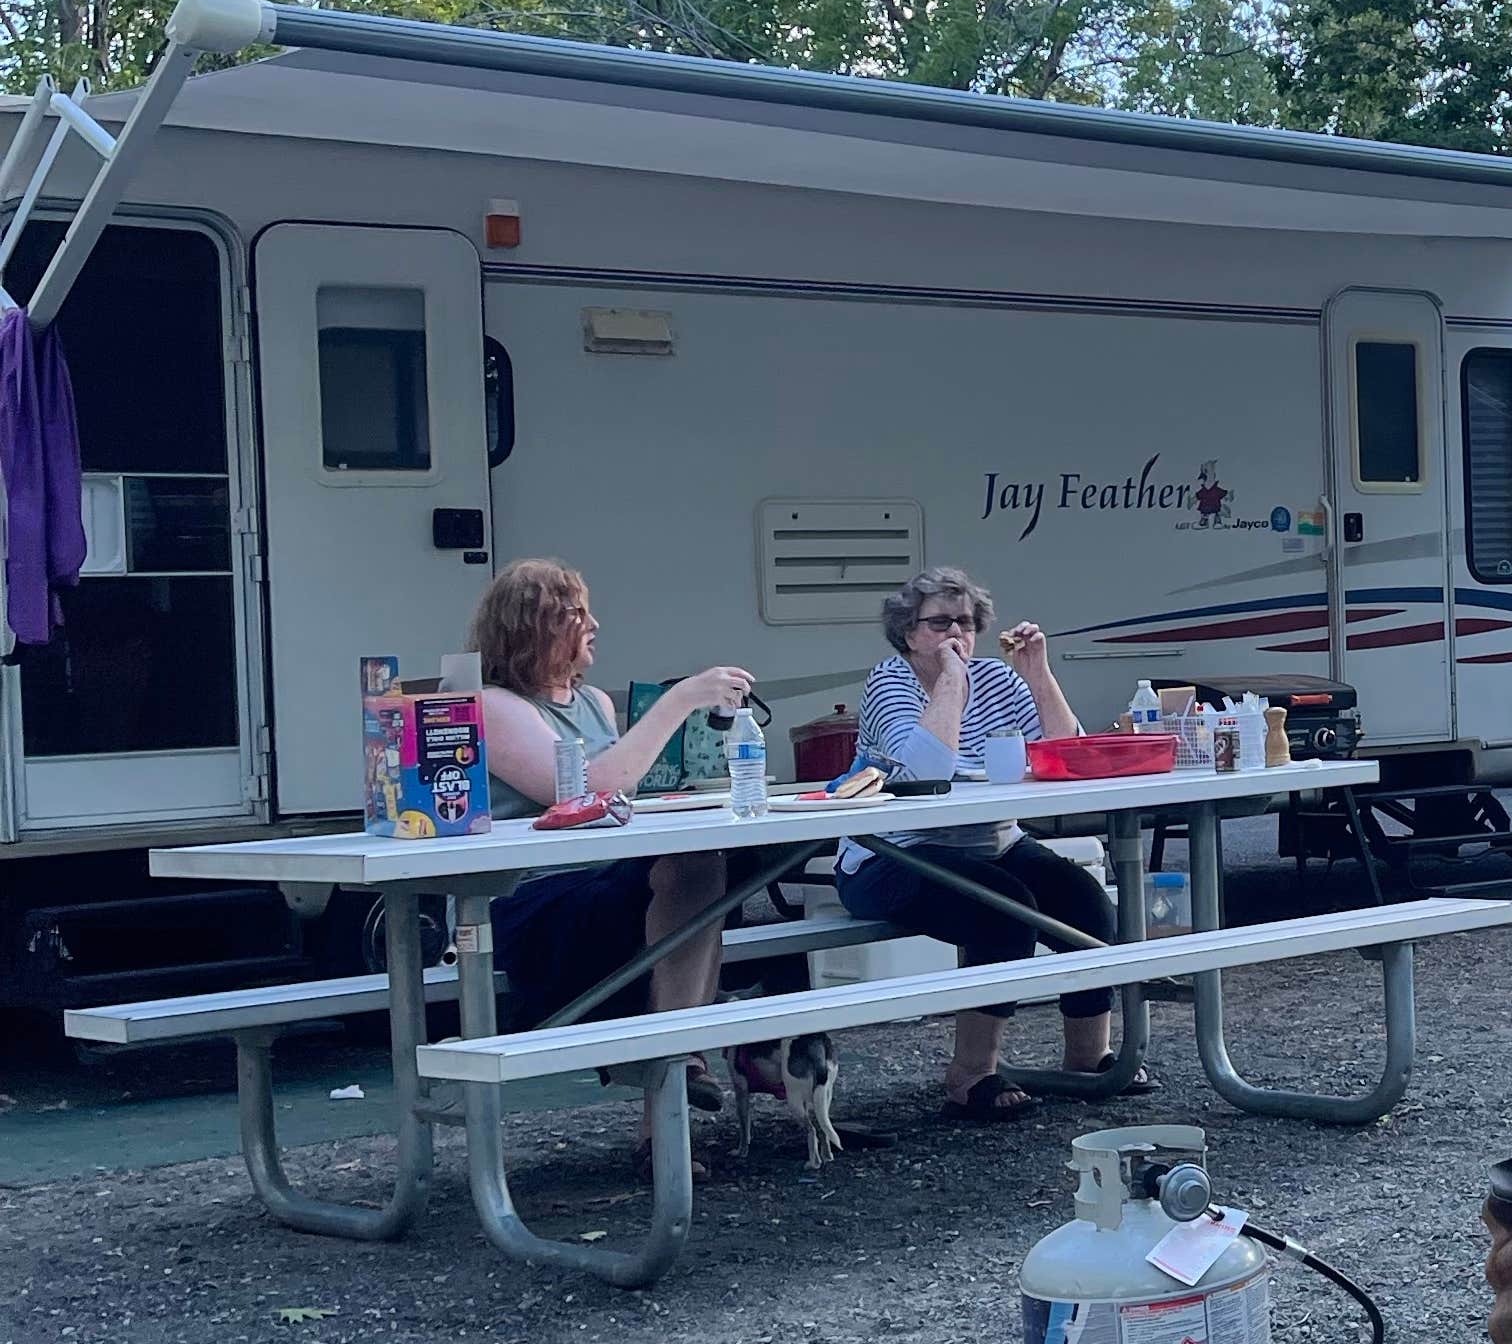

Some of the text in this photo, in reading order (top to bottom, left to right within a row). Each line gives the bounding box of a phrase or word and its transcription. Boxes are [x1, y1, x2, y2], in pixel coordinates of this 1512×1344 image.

[981, 453, 1190, 543] Jay Feather
[1231, 518, 1269, 532] Jayco
[431, 779, 471, 794] BLAST
